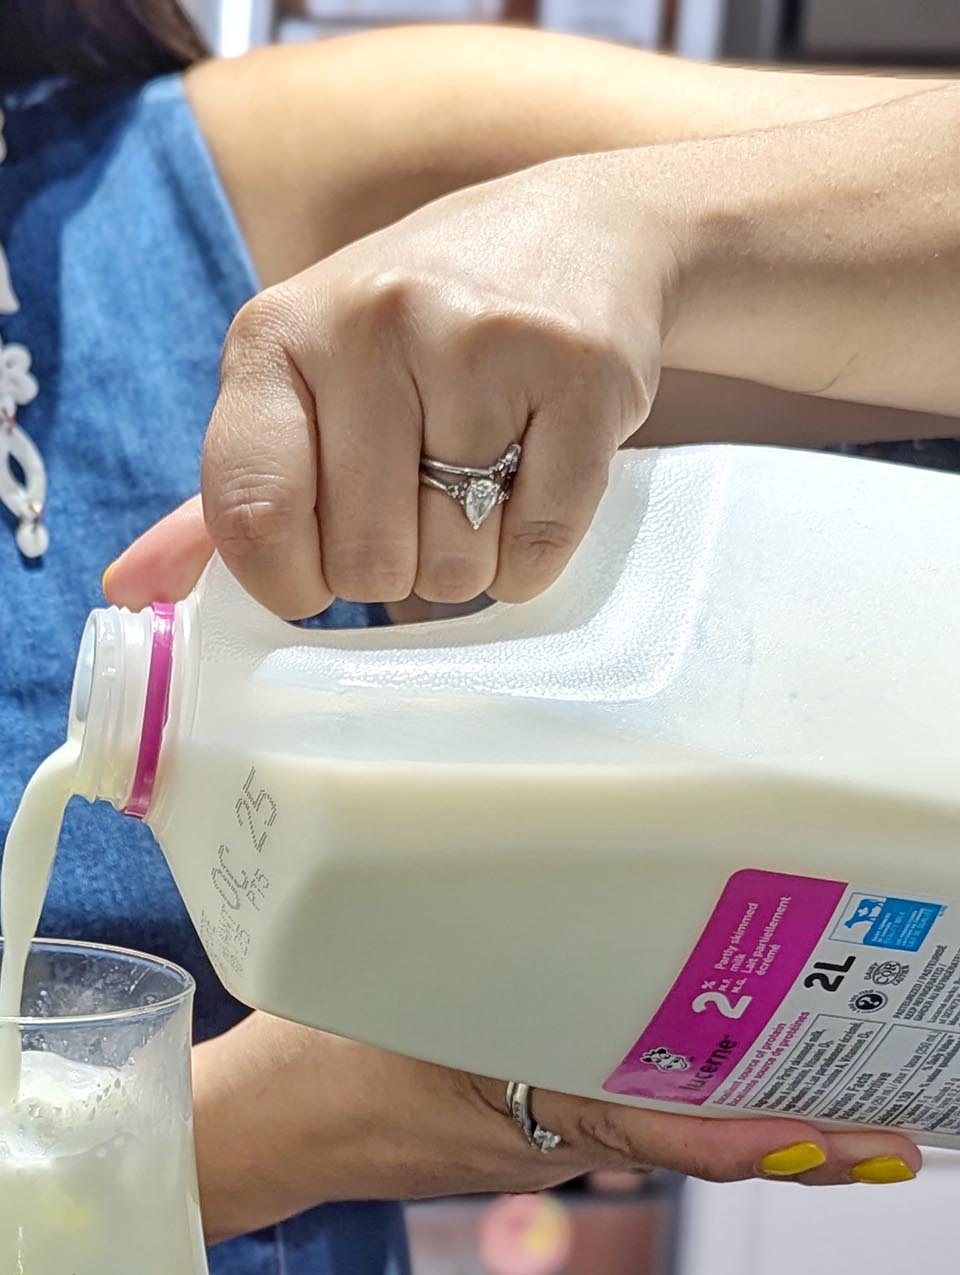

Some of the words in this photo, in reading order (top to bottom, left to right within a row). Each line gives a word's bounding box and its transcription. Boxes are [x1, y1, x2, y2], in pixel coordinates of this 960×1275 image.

[235, 766, 277, 852] 25
[715, 946, 738, 969] Partly
[731, 903, 758, 944] skimmed
[730, 954, 746, 971] milk
[741, 958, 759, 973] Lait
[754, 897, 791, 957] partiellement
[738, 1059, 760, 1080] source
[755, 1050, 766, 1058] of
[762, 1023, 786, 1049] protein
[755, 1058, 776, 1078] source
[780, 1012, 810, 1046] protéines
[847, 1073, 873, 1092] Facts
[860, 1073, 891, 1100] nutritive
